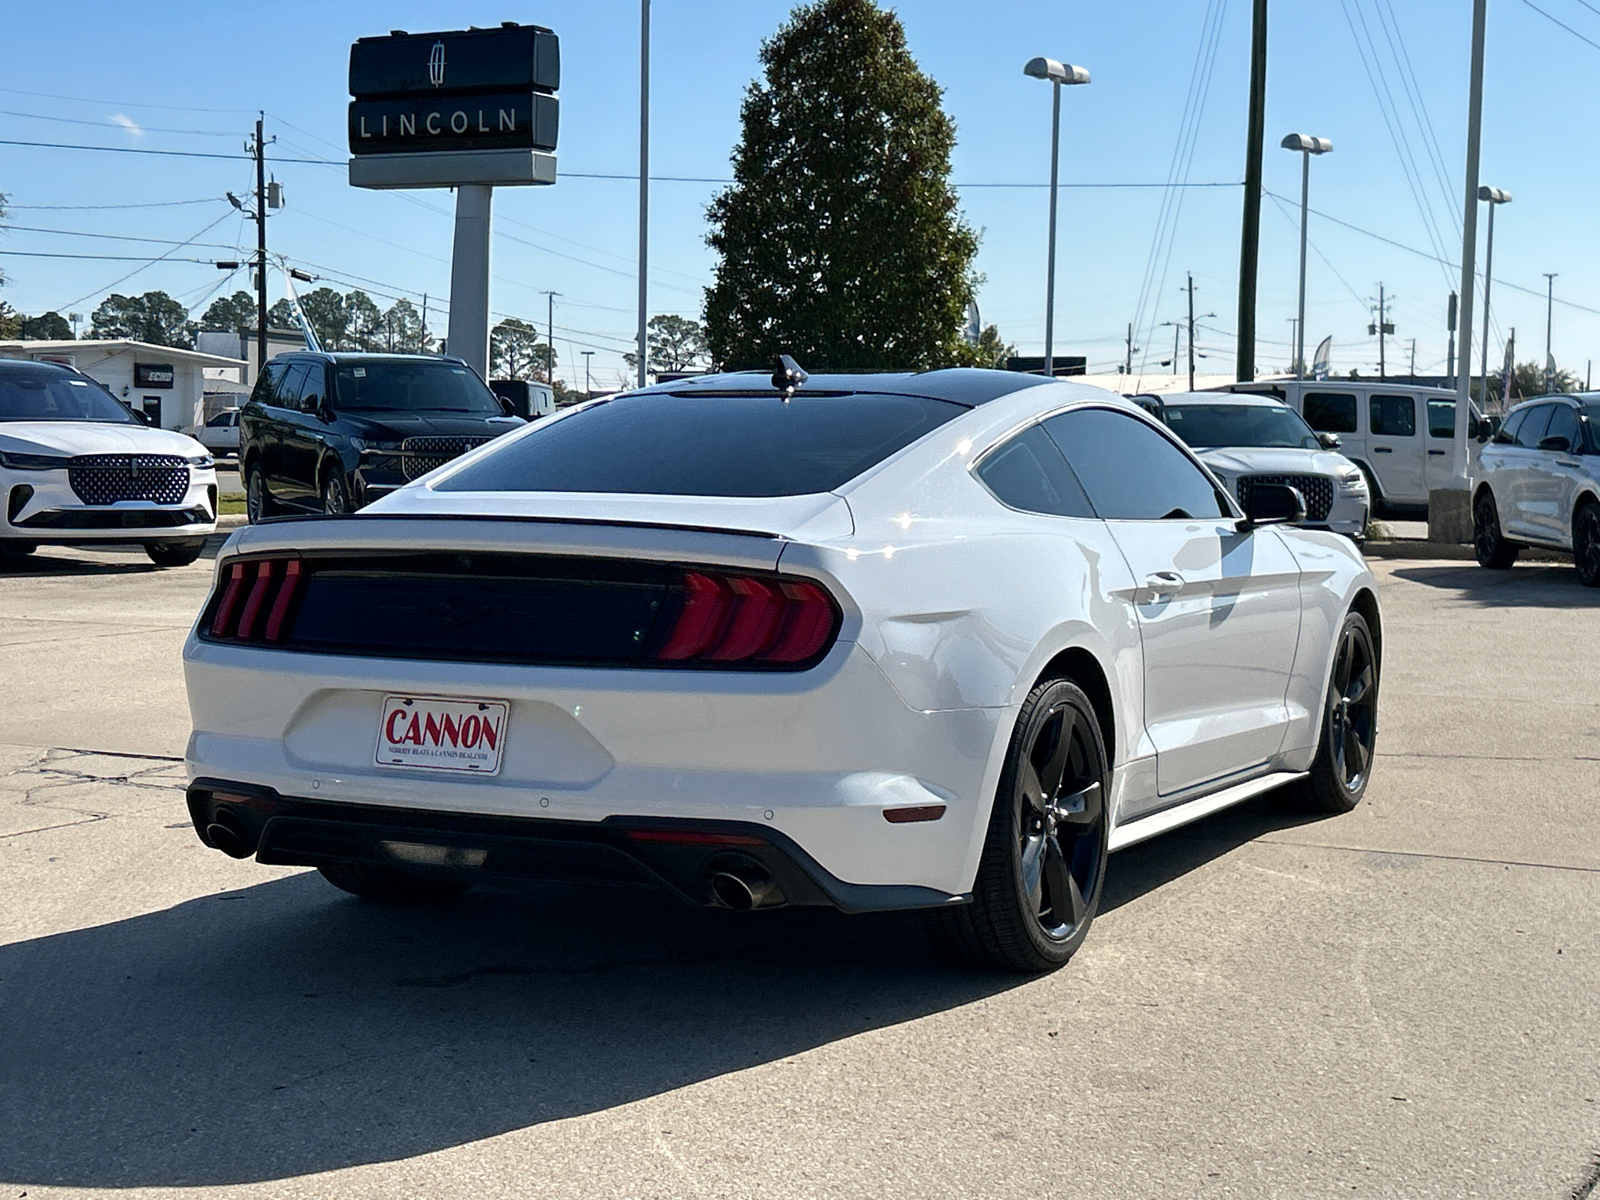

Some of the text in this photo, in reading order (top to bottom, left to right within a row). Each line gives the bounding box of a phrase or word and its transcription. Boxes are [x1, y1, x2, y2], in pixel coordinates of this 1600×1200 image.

[361, 108, 516, 138] LINCOLN
[147, 371, 172, 382] ECHO
[386, 708, 500, 751] CANNON
